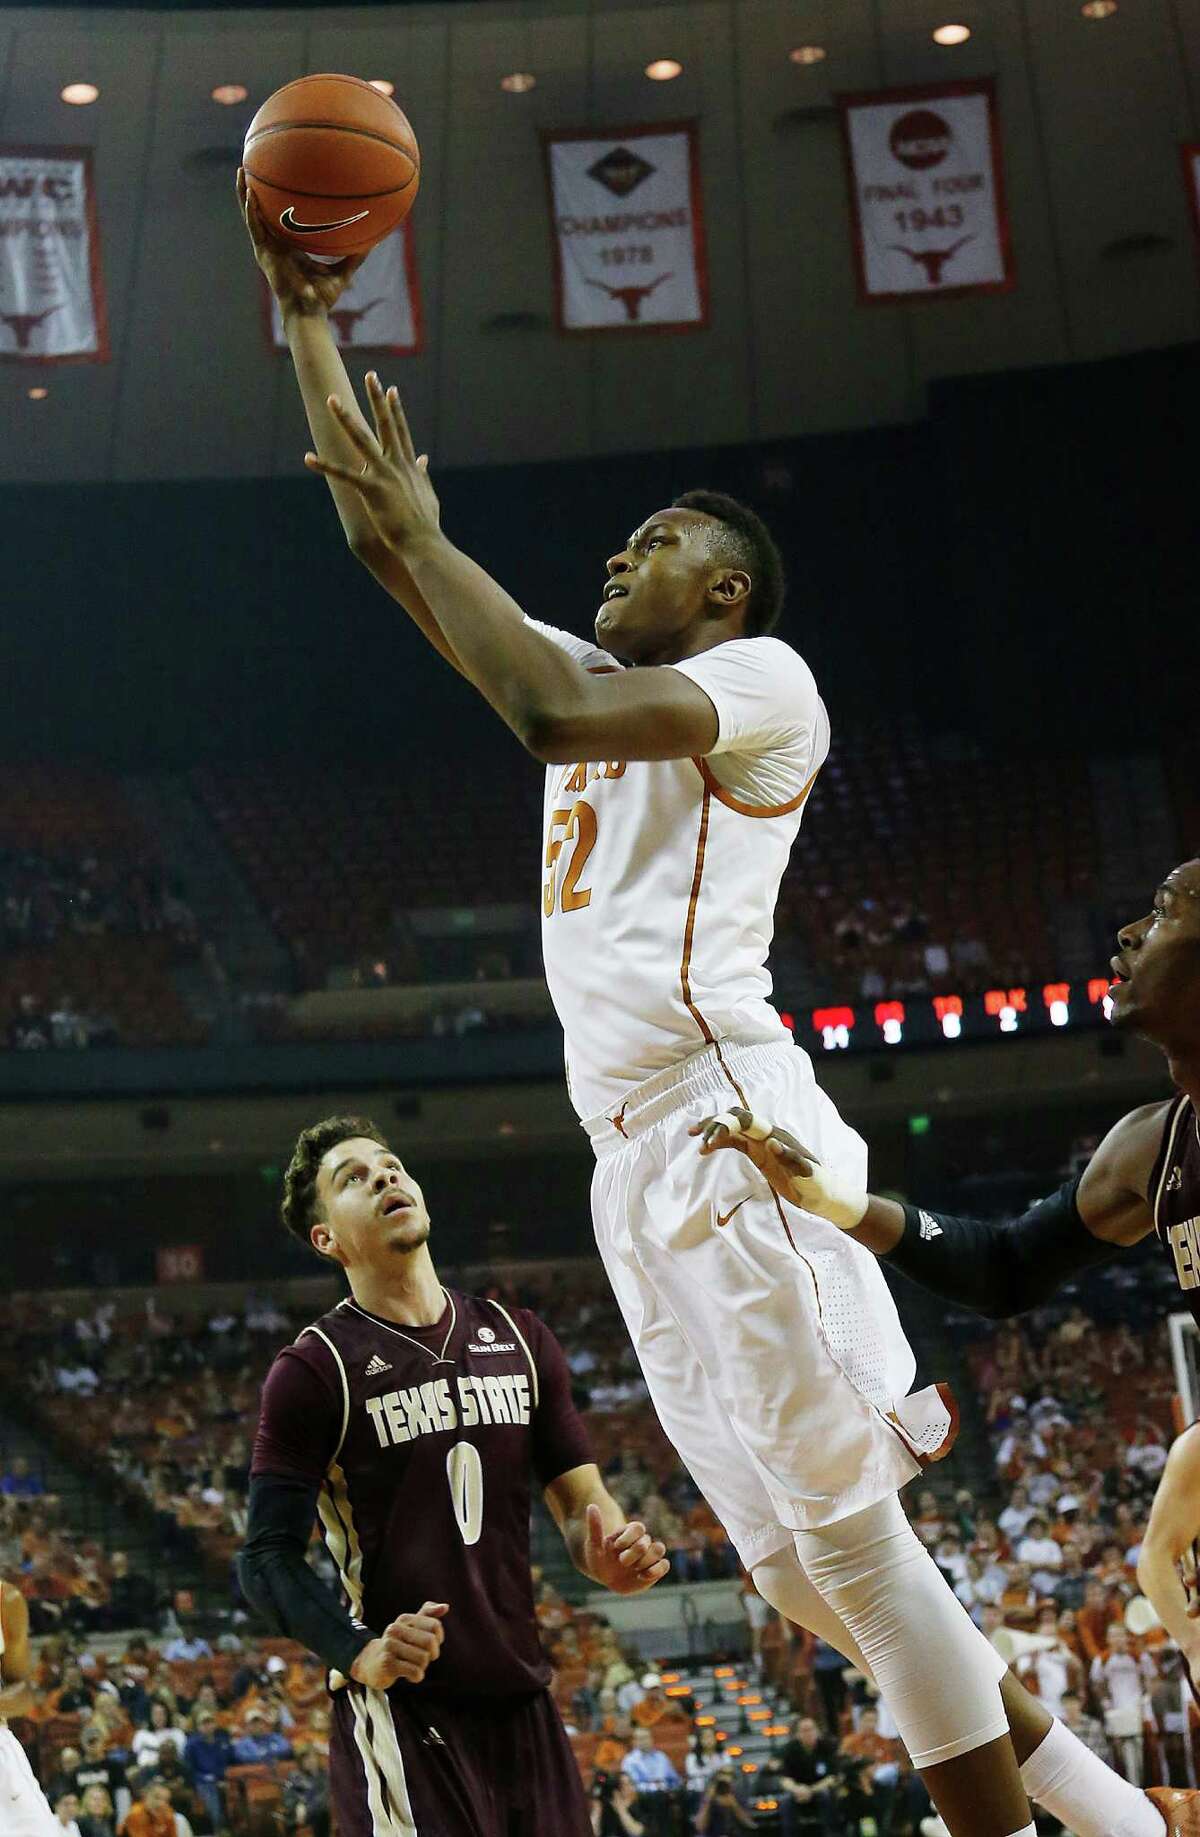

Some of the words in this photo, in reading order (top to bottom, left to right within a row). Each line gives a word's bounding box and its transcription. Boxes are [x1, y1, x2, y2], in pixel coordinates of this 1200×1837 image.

[556, 206, 689, 236] CHAMPIONS
[894, 203, 965, 232] 1943
[542, 799, 599, 918] 52
[364, 1363, 393, 1377] adidas
[365, 1378, 458, 1449] TEXAS
[457, 1374, 531, 1427] STATE
[446, 1440, 484, 1546] 0
